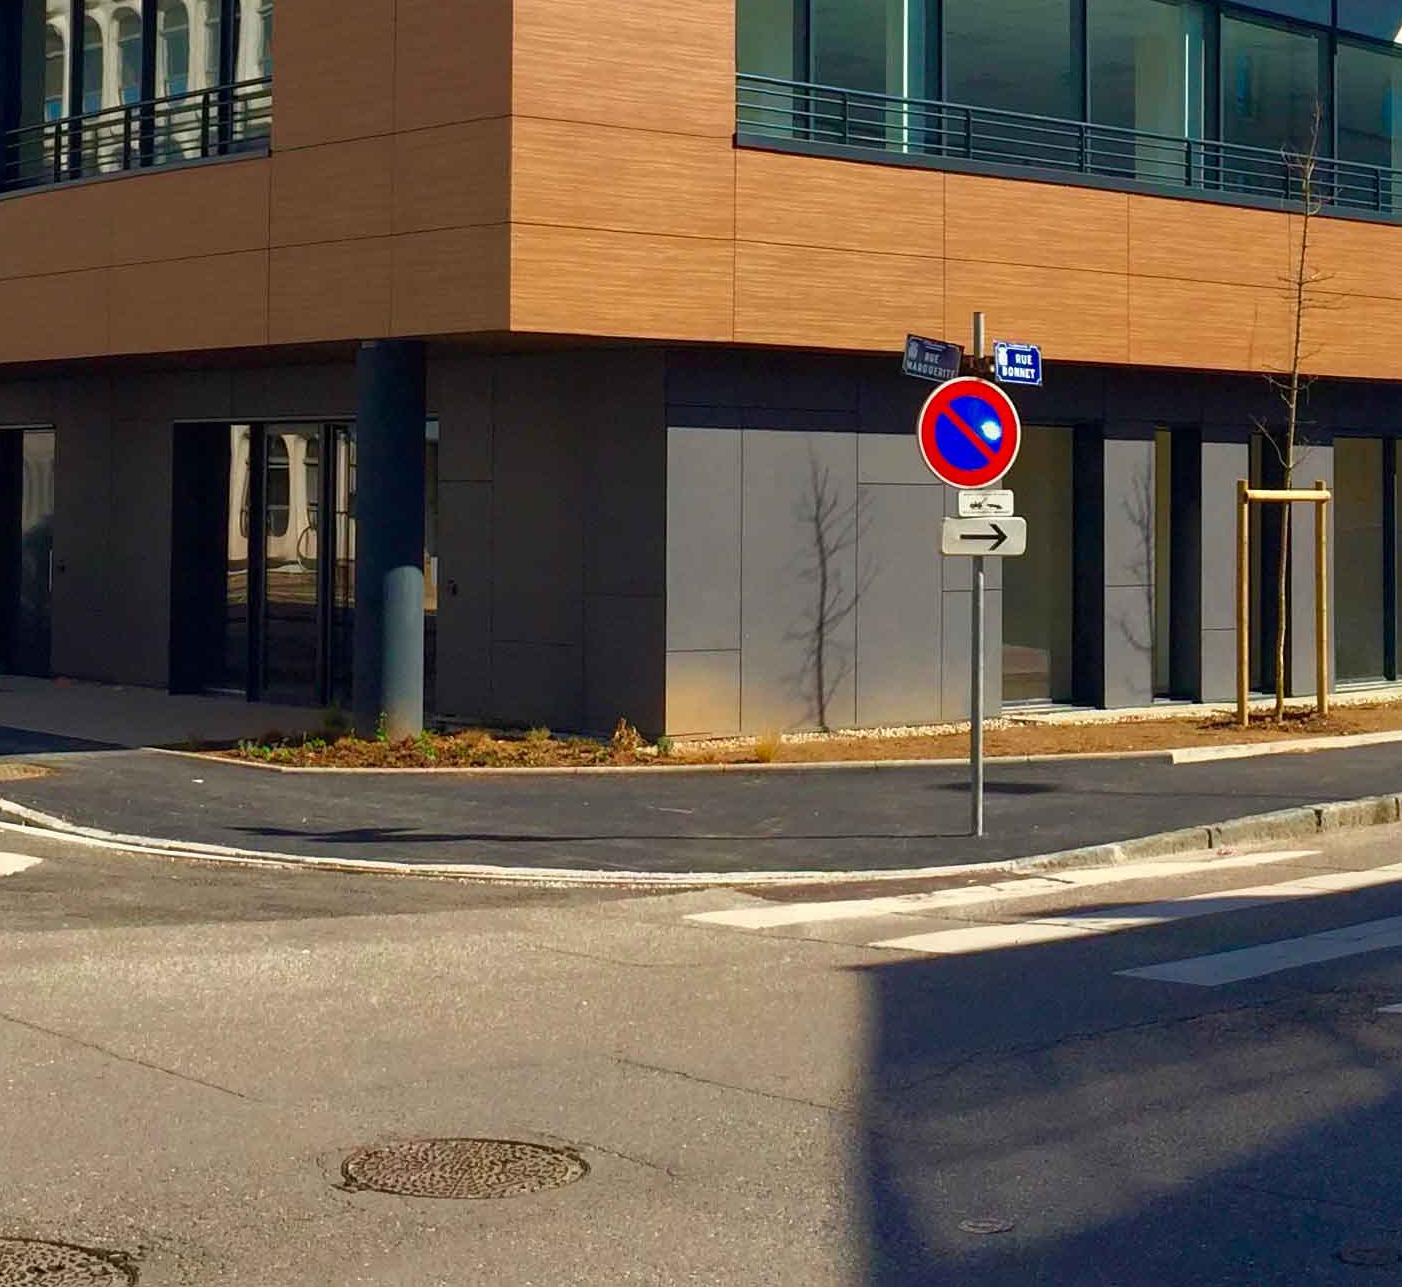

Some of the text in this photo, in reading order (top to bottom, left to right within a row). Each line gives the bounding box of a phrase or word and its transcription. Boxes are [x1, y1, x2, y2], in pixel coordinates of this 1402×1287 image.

[924, 352, 941, 364] RUE
[1015, 353, 1033, 365] RUE
[1002, 366, 1035, 379] BONNET
